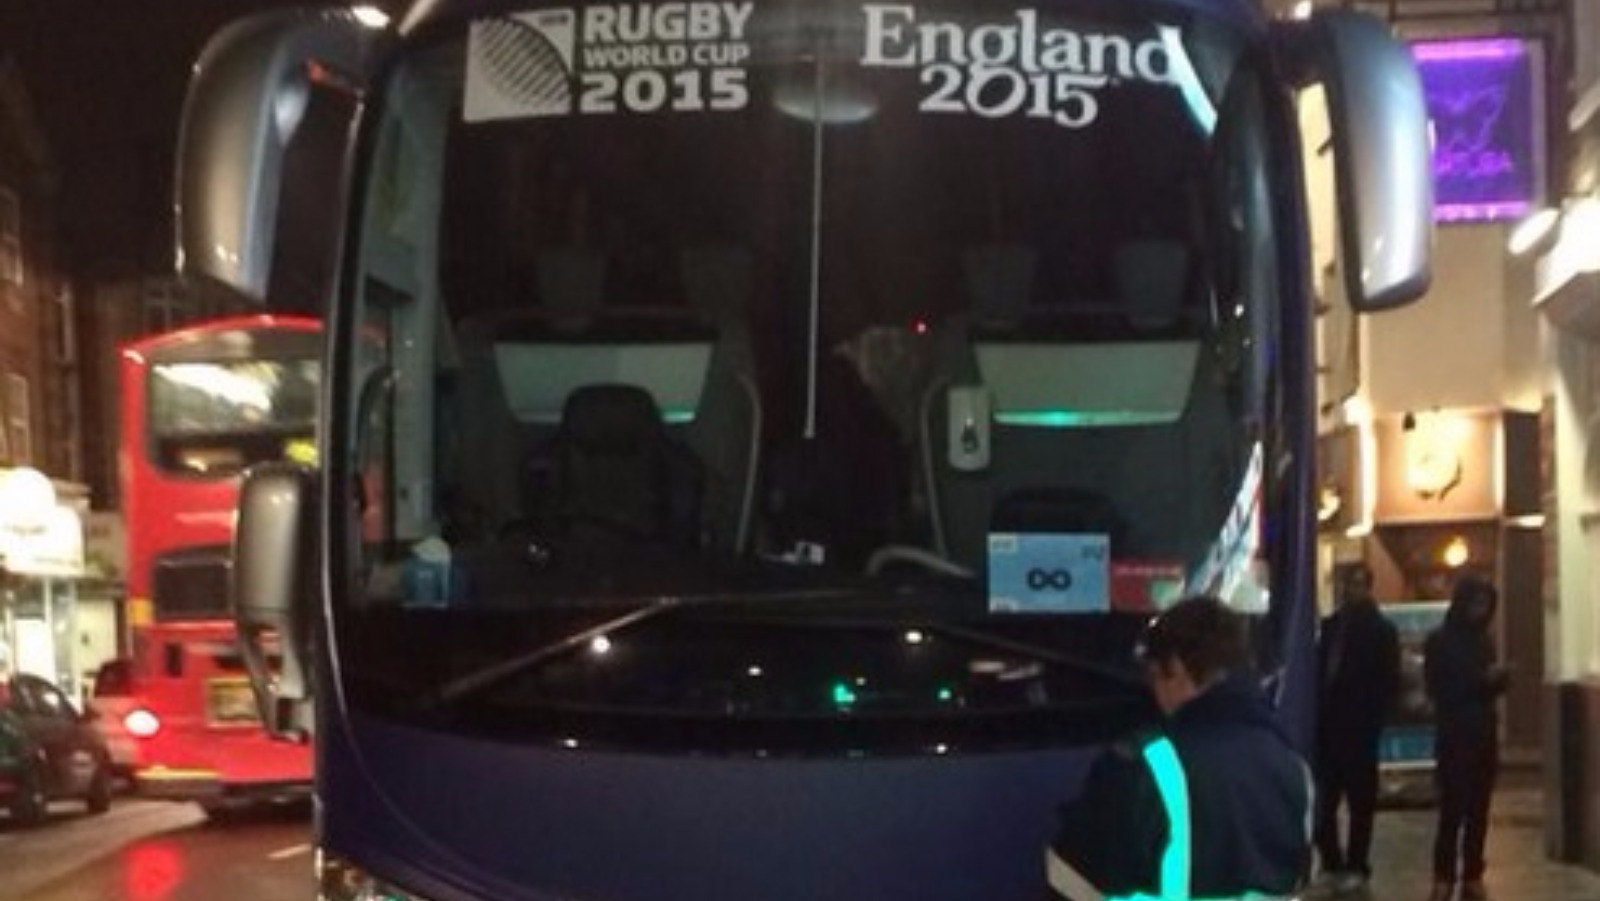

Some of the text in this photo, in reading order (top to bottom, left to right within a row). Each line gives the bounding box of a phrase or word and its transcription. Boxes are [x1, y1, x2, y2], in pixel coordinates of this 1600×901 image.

[582, 2, 754, 43] RUGBY
[860, 3, 1182, 84] England
[584, 43, 750, 68] WORLD CUP
[579, 67, 750, 114] 2015
[919, 63, 1107, 128] 2015
